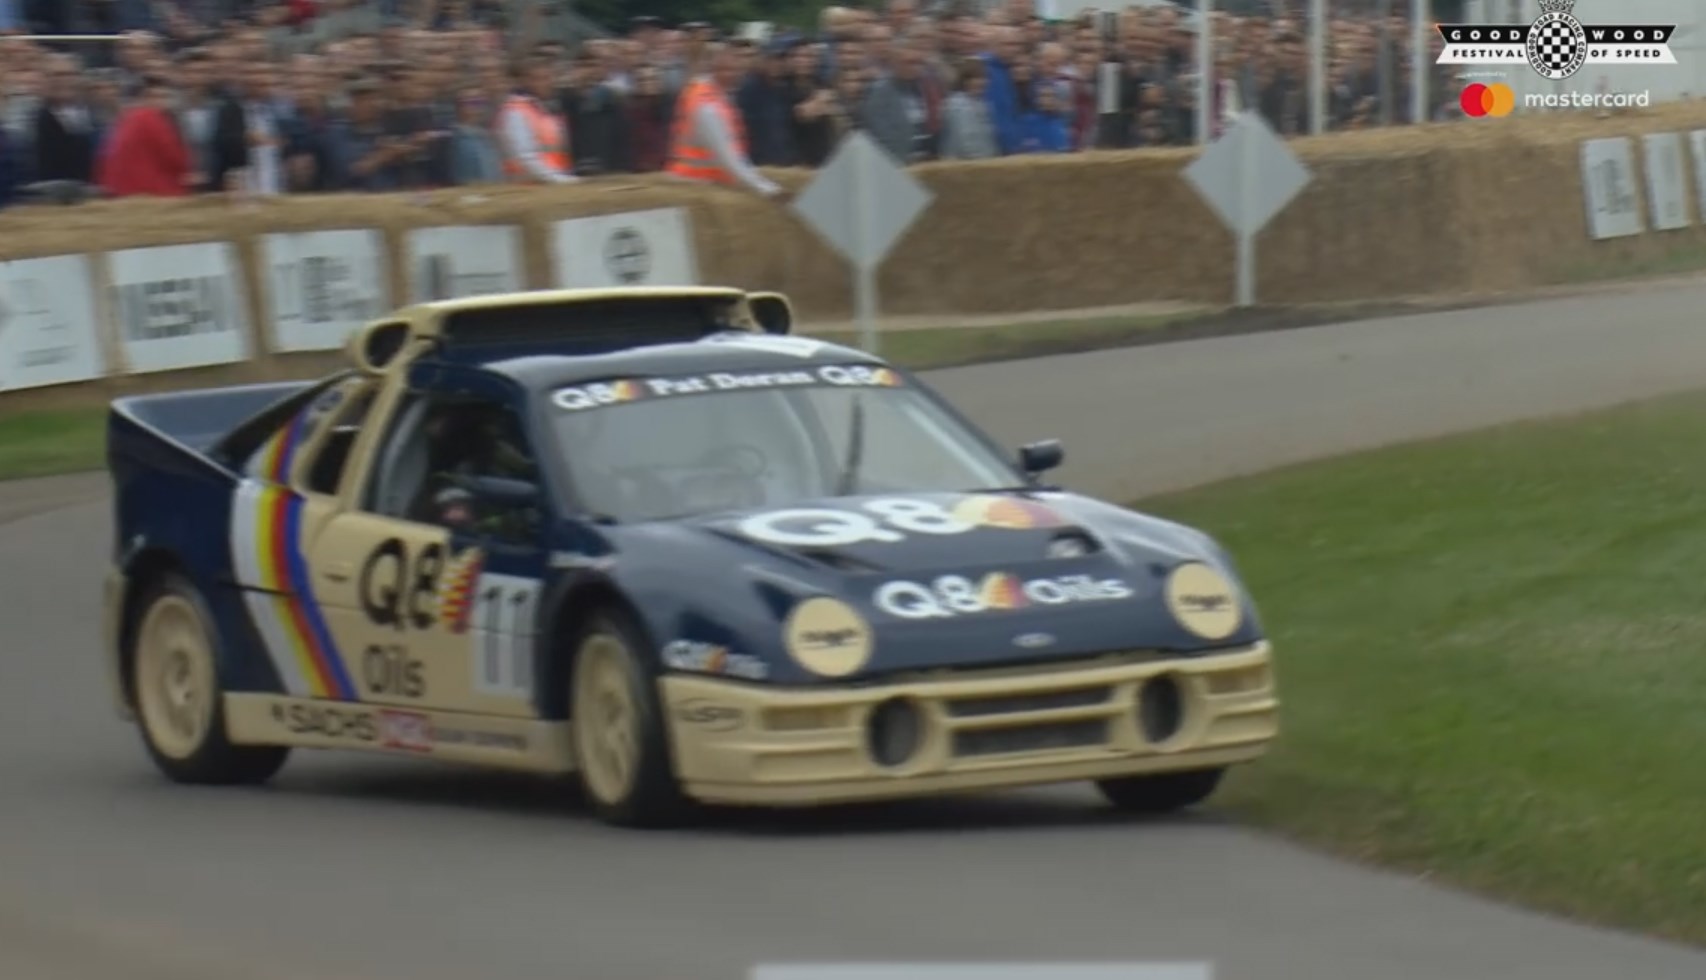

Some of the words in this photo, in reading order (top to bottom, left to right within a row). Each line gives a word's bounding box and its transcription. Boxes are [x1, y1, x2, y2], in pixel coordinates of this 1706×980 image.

[553, 384, 617, 409] Q8
[818, 366, 875, 385] Q8
[740, 500, 977, 546] Q8
[358, 537, 447, 631] Q8
[874, 574, 985, 620] Q8
[1025, 574, 1134, 604] Oils
[482, 585, 530, 689] 11
[362, 643, 426, 698] Oils
[287, 704, 377, 743] SACHS
